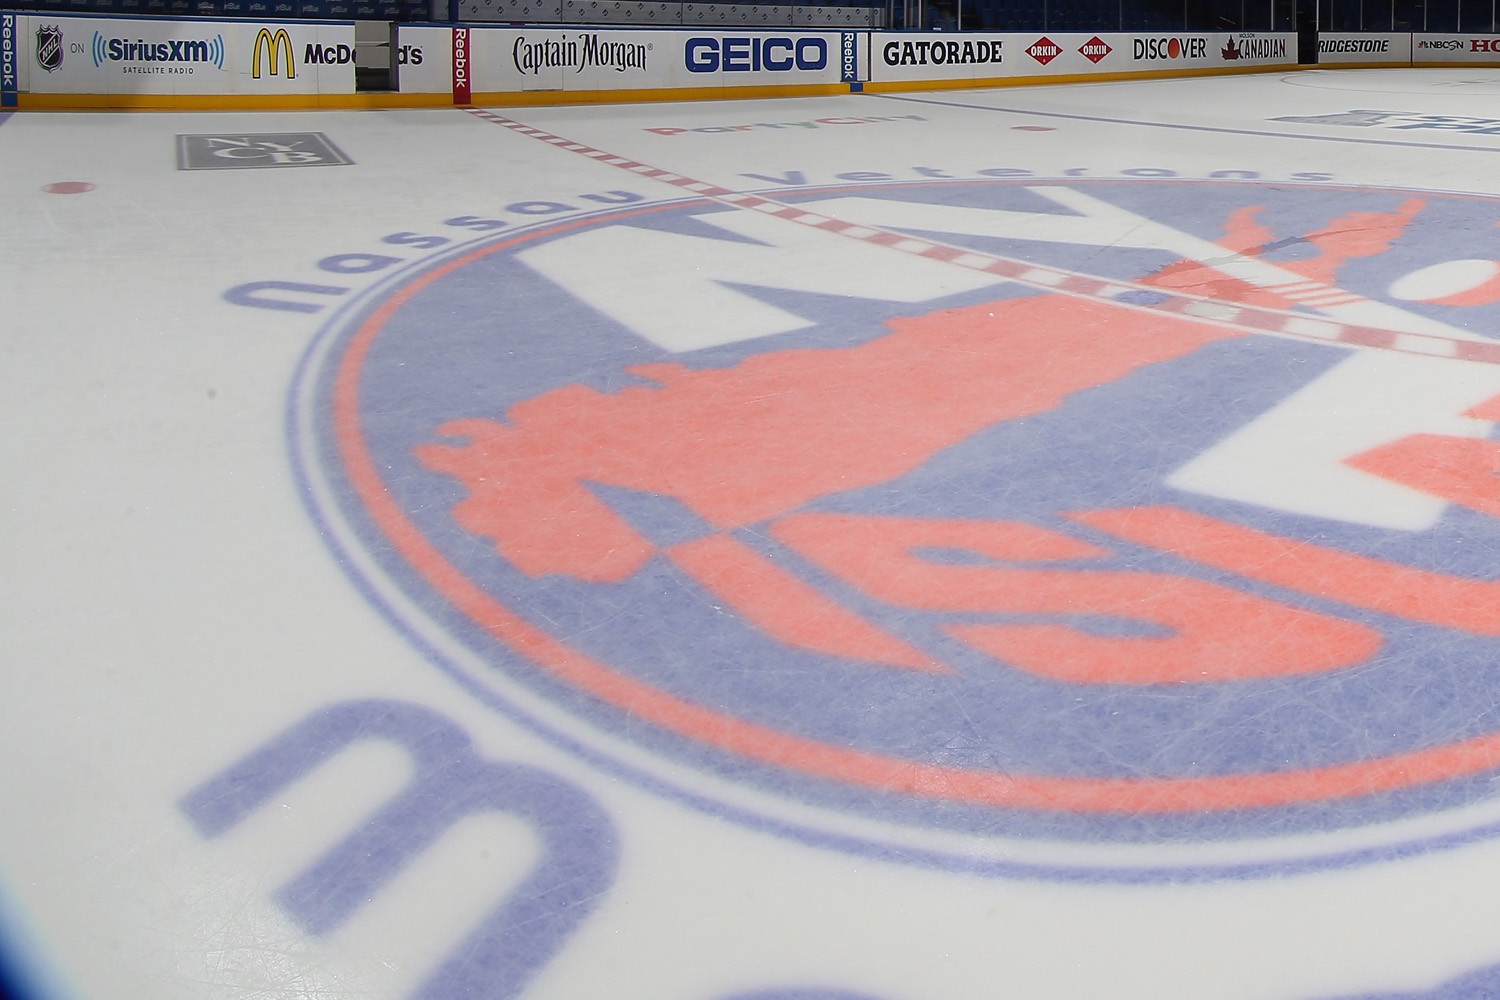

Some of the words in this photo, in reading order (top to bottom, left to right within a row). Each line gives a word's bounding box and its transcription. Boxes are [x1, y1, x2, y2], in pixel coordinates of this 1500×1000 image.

[1, 13, 15, 86] Reebok
[70, 43, 85, 53] ON
[304, 43, 423, 65] McDd's
[455, 28, 467, 88] Reebok
[513, 36, 577, 75] Captain
[576, 34, 648, 74] Morgan
[685, 37, 828, 73] GEICO
[843, 32, 854, 80] Reebok
[883, 40, 1003, 66] GATORADE
[1030, 44, 1057, 57] ORKIN
[1082, 43, 1107, 56] ORKIN
[1133, 37, 1207, 60] DISCOVER
[1239, 38, 1286, 58] CANADIAN
[1317, 40, 1389, 53] RIDGESTONE
[123, 66, 165, 75] SATELLITE
[169, 67, 194, 75] RADIO
[223, 187, 645, 315] nassau
